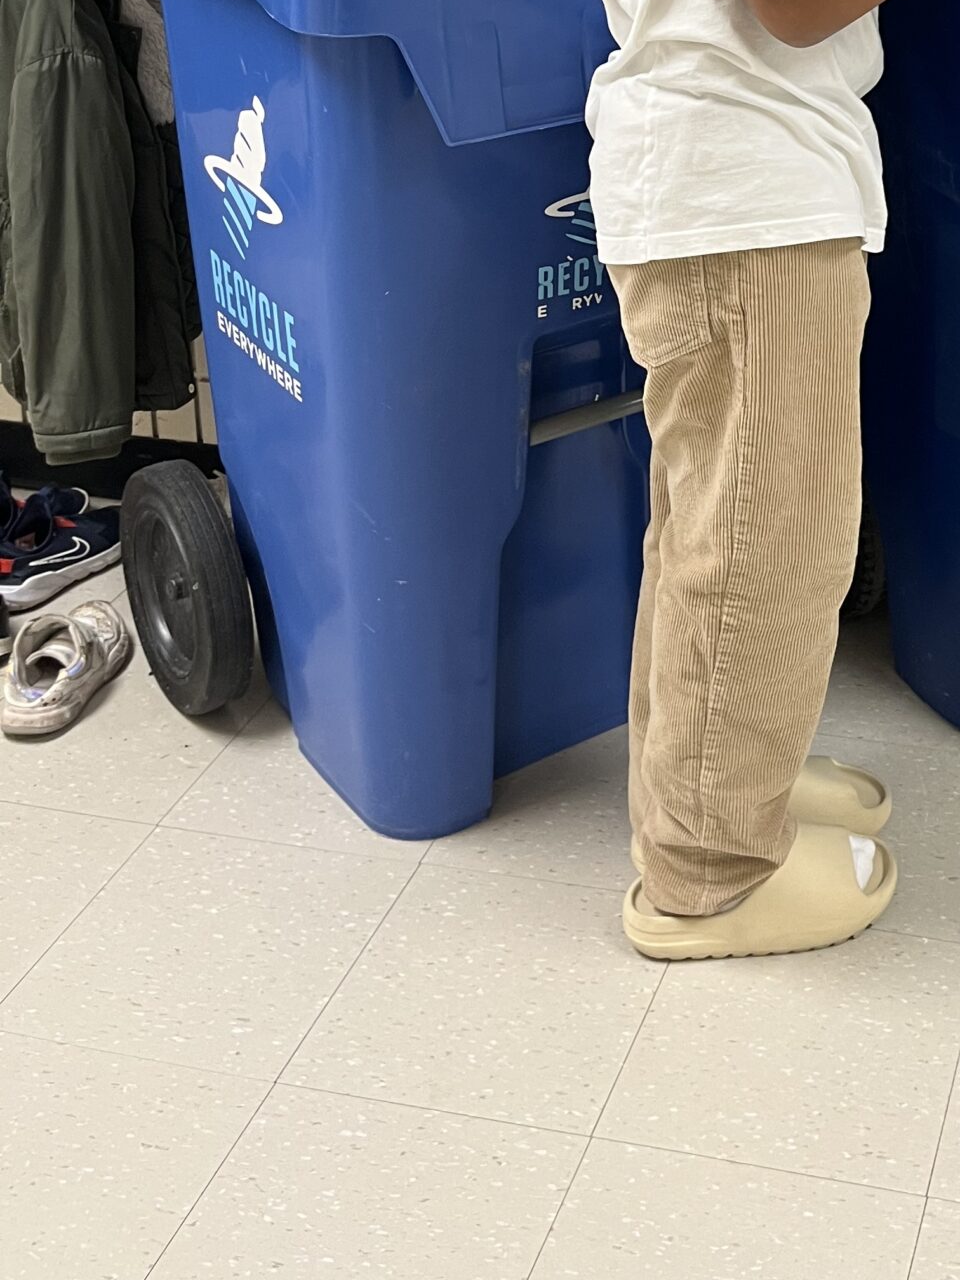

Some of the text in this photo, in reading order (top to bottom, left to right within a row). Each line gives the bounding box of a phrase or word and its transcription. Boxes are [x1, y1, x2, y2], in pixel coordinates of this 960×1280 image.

[210, 249, 300, 373] RECYCLE
[537, 254, 605, 300] RECY
[216, 310, 303, 402] EVERYWHERE
